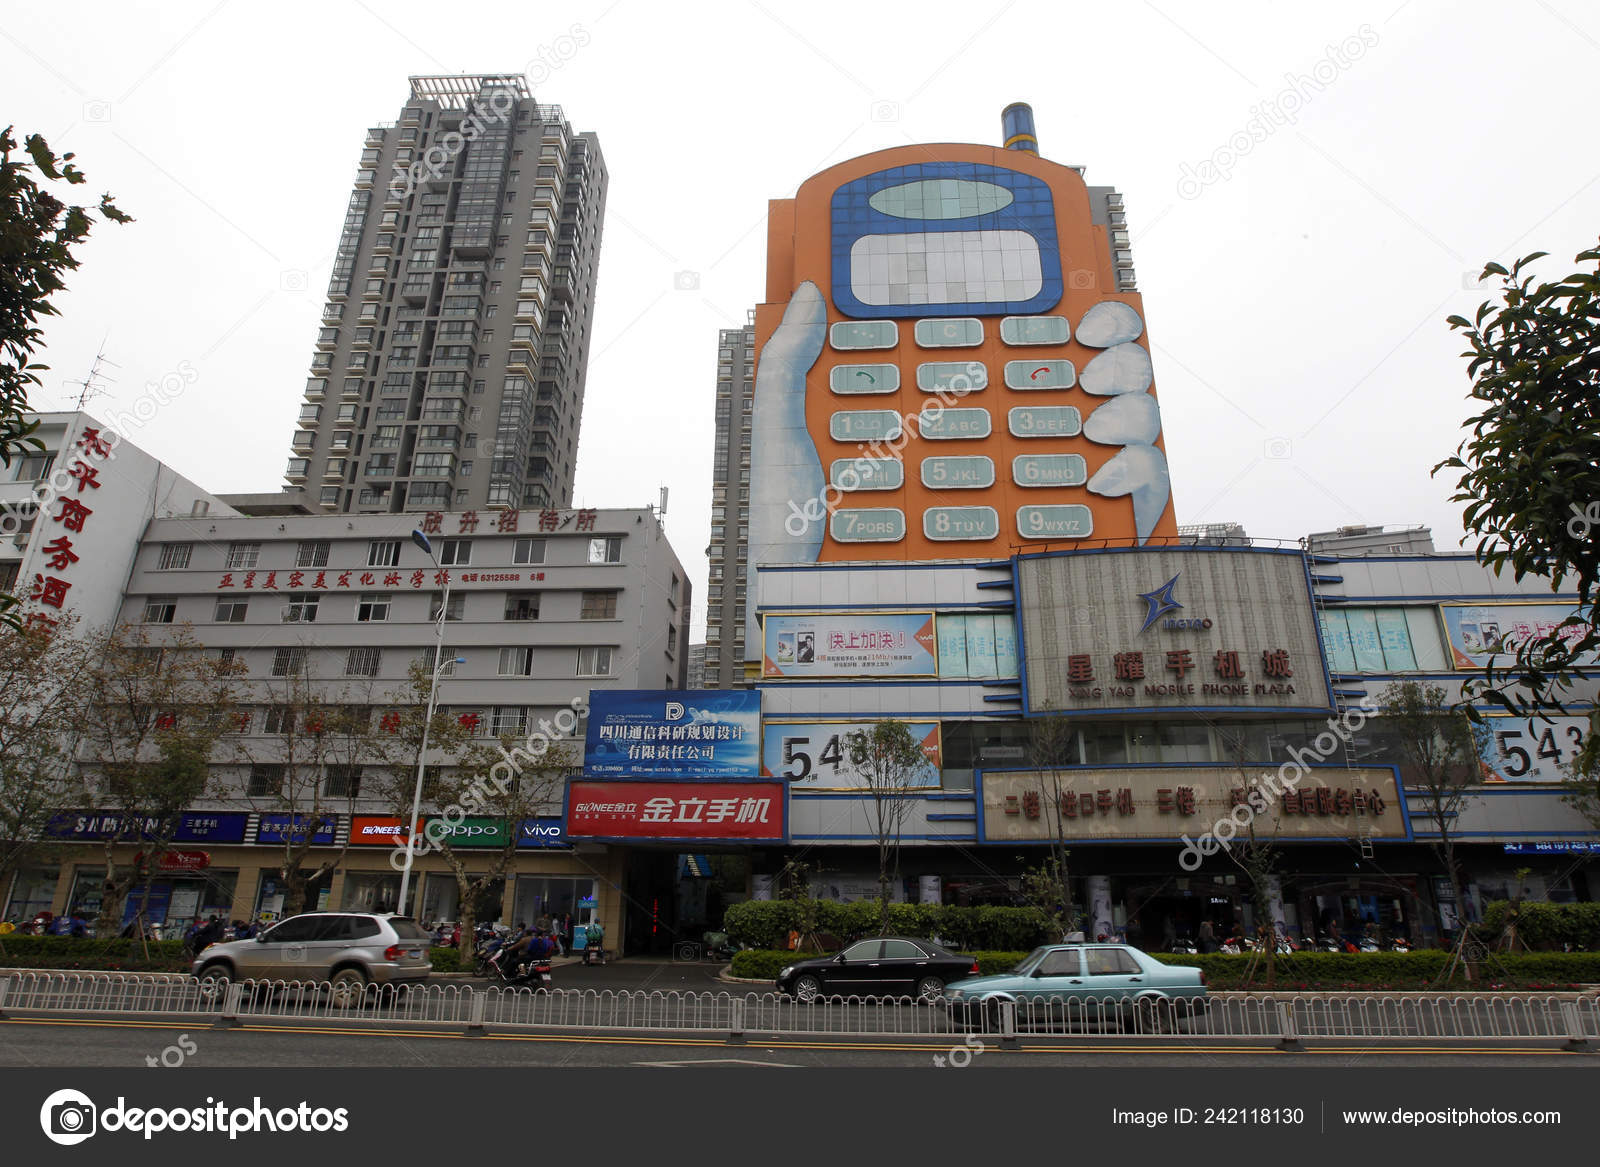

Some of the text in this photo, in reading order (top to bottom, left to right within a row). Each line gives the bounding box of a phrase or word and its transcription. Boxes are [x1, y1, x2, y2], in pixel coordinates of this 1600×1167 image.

[944, 325, 957, 338] C
[949, 420, 980, 431] ABC
[1019, 413, 1067, 431] 3 DEF
[932, 462, 981, 481] 5 JKL
[1024, 461, 1040, 480] 6
[422, 508, 597, 533] 欣升招待所
[935, 513, 986, 532] 8 TUV
[1029, 511, 1044, 531] 9
[217, 568, 451, 591] 亚星美容美发化妆学校
[1067, 648, 1294, 683] 星耀手机城
[1068, 683, 1296, 699] XING YAO MOBILE PHONE PLAZA
[600, 725, 745, 741] 四川通信科研规划设计
[629, 745, 715, 760] 有限责任公司
[640, 797, 771, 823] 金立手机
[1005, 790, 1040, 818] 二楼
[1062, 788, 1136, 817] 进口手机
[1157, 786, 1197, 815] 三楼
[74, 817, 171, 833] SAMN
